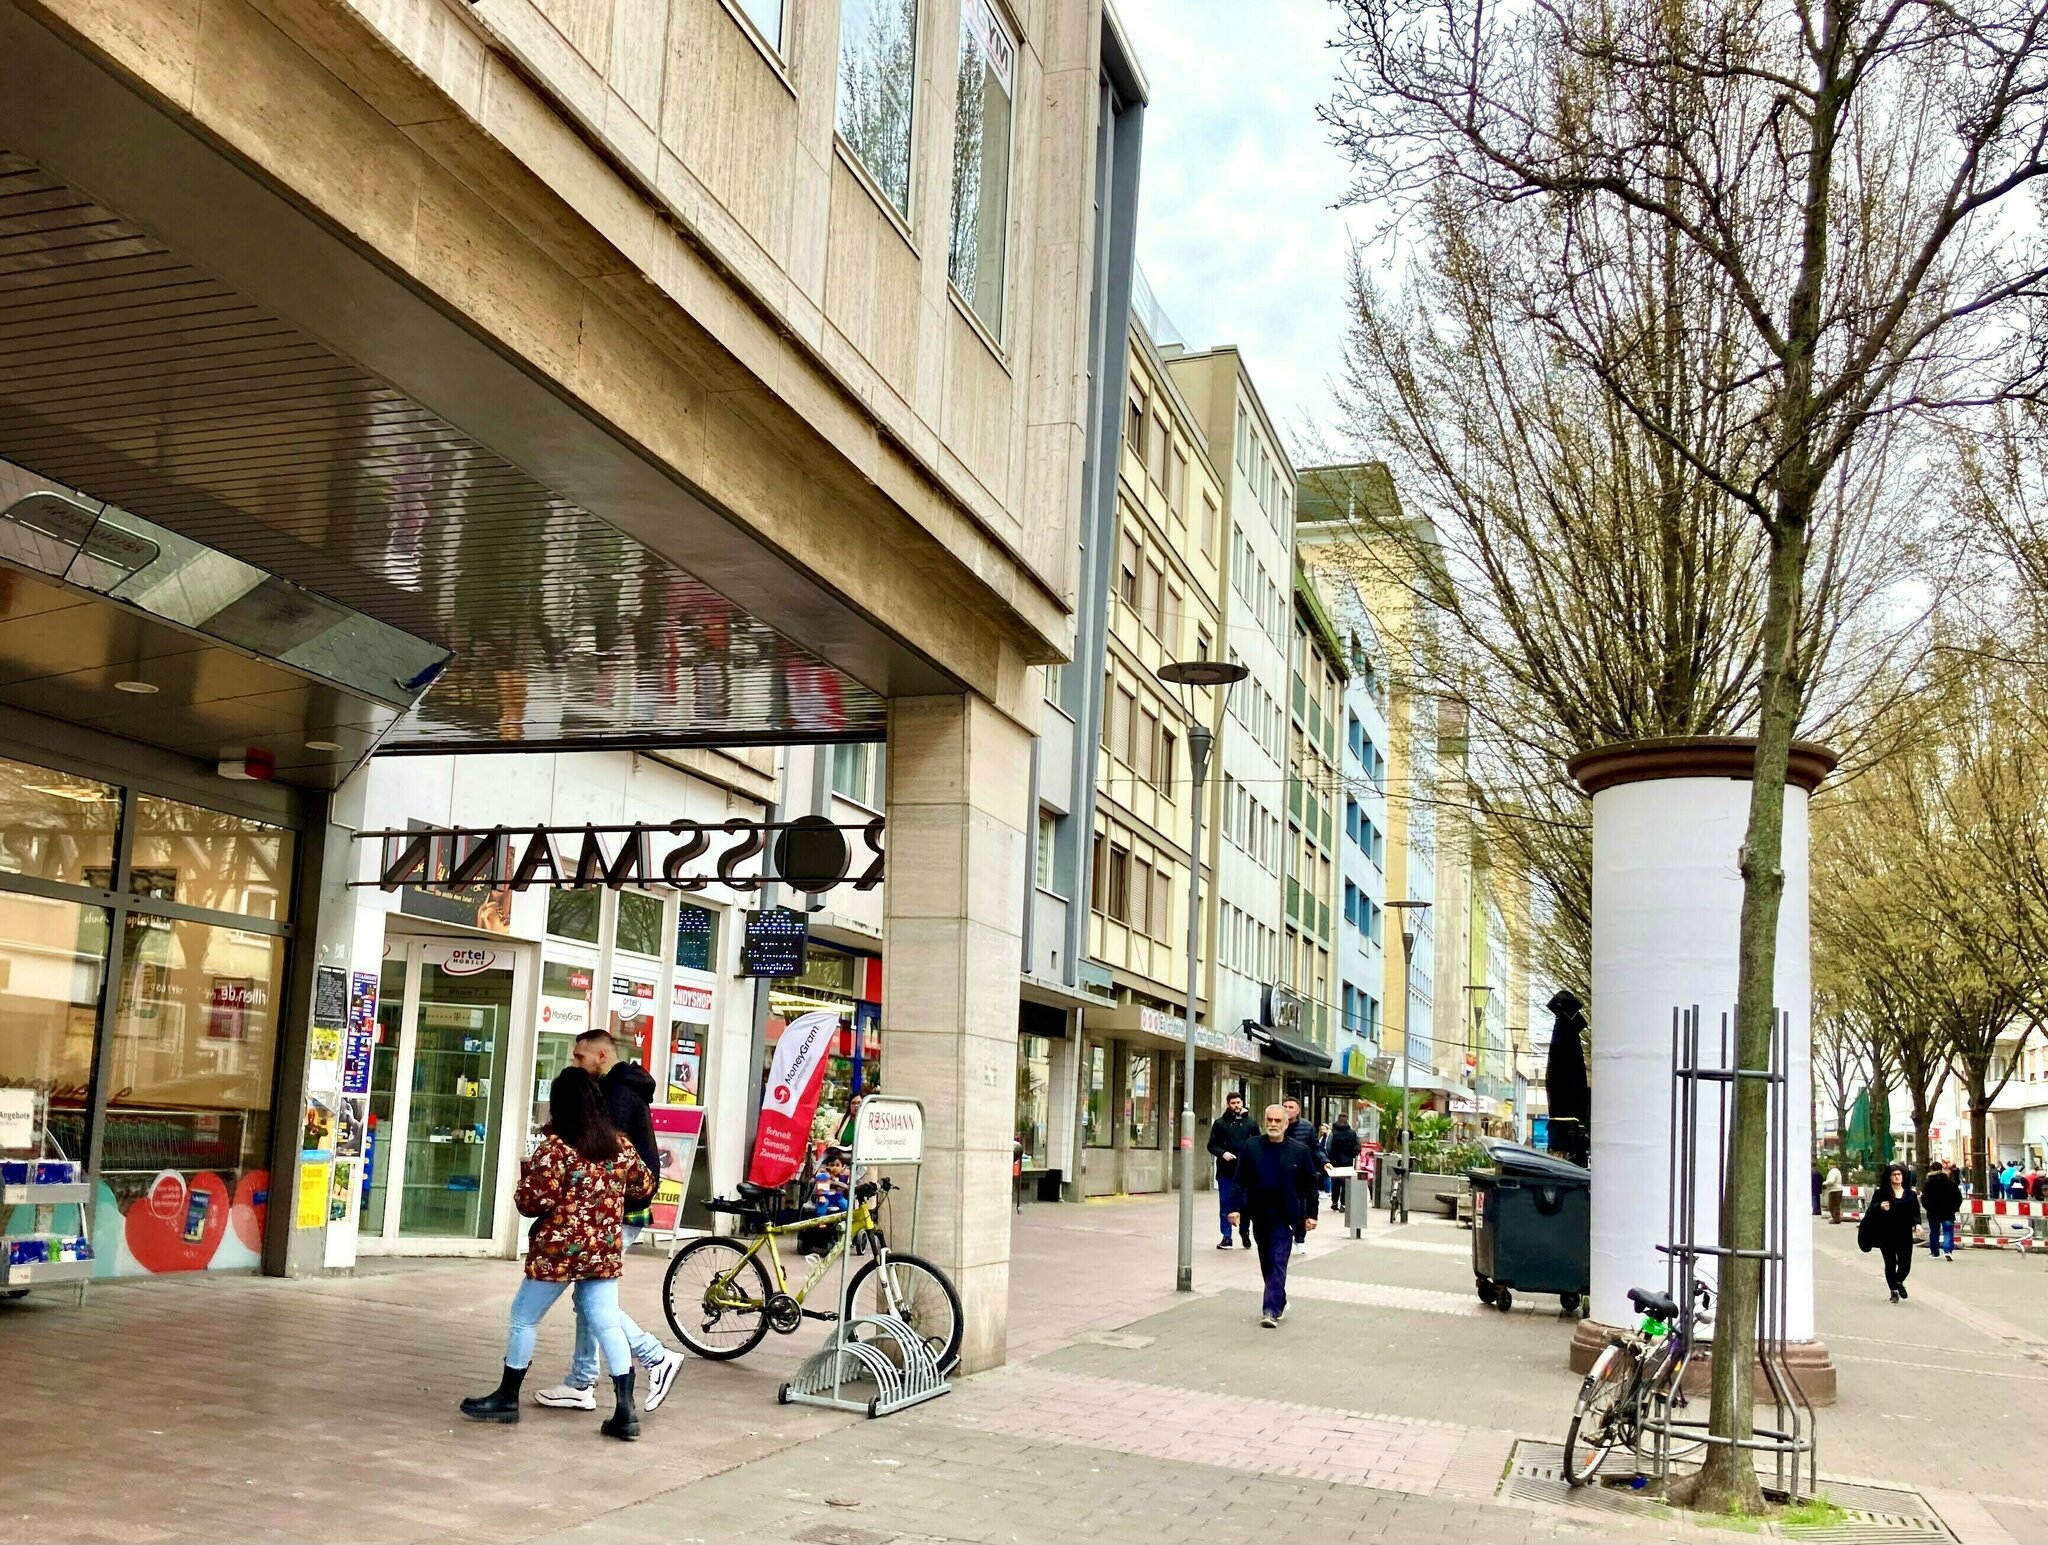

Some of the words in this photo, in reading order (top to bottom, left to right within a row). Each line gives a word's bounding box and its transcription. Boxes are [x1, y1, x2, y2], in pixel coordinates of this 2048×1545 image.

[453, 950, 485, 960] ortel
[551, 1010, 583, 1021] MoneyGram
[785, 1025, 819, 1086] MoneyGram
[868, 1111, 915, 1131] ROSSMANN
